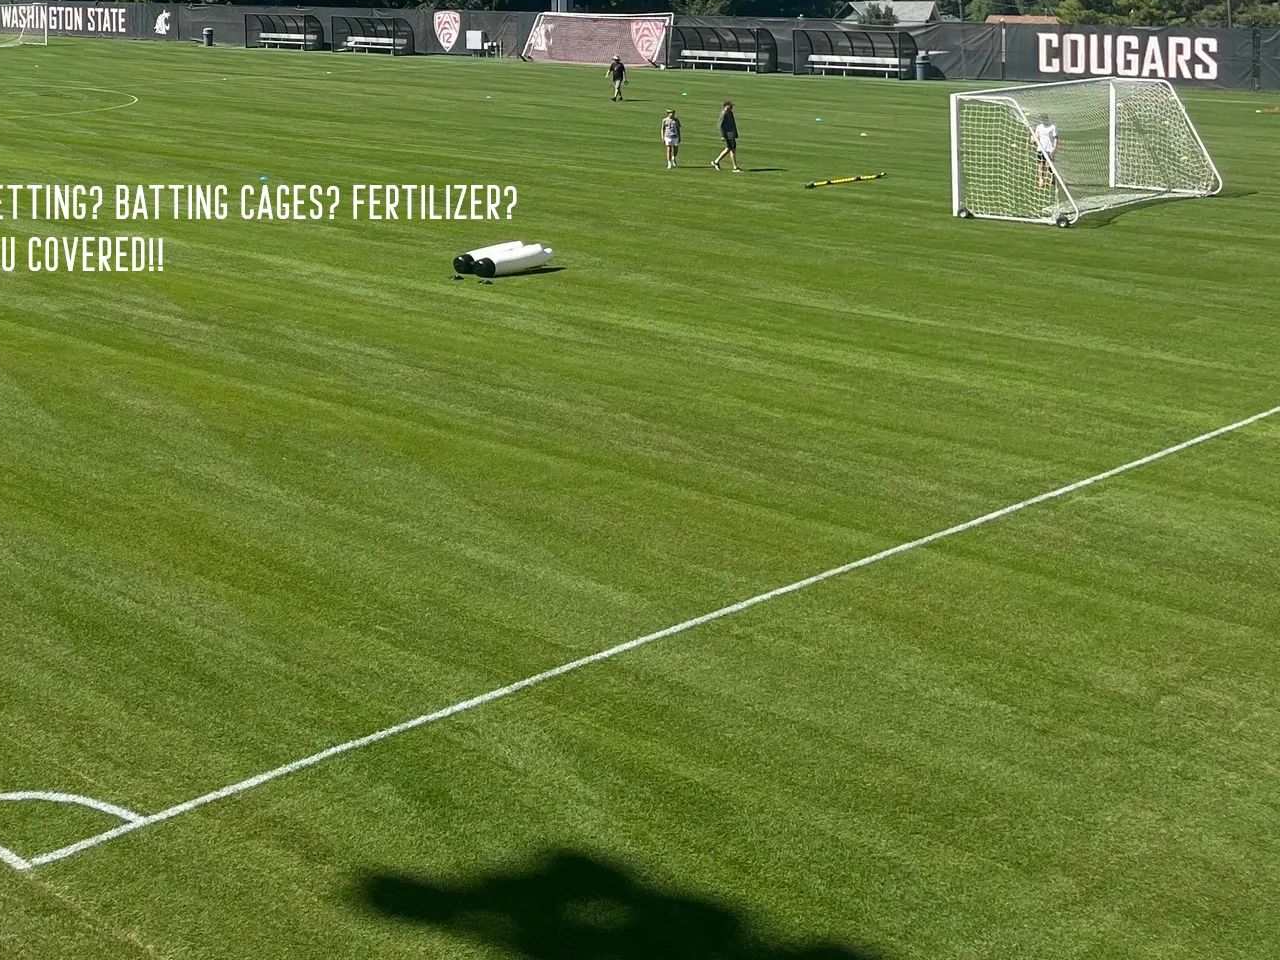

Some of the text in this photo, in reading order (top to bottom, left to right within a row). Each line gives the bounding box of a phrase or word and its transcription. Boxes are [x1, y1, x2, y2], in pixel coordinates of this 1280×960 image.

[1, 5, 126, 33] WASHINGTON STATE
[442, 32, 453, 44] 12
[641, 39, 654, 52] 12
[1037, 32, 1218, 80] COUGARS
